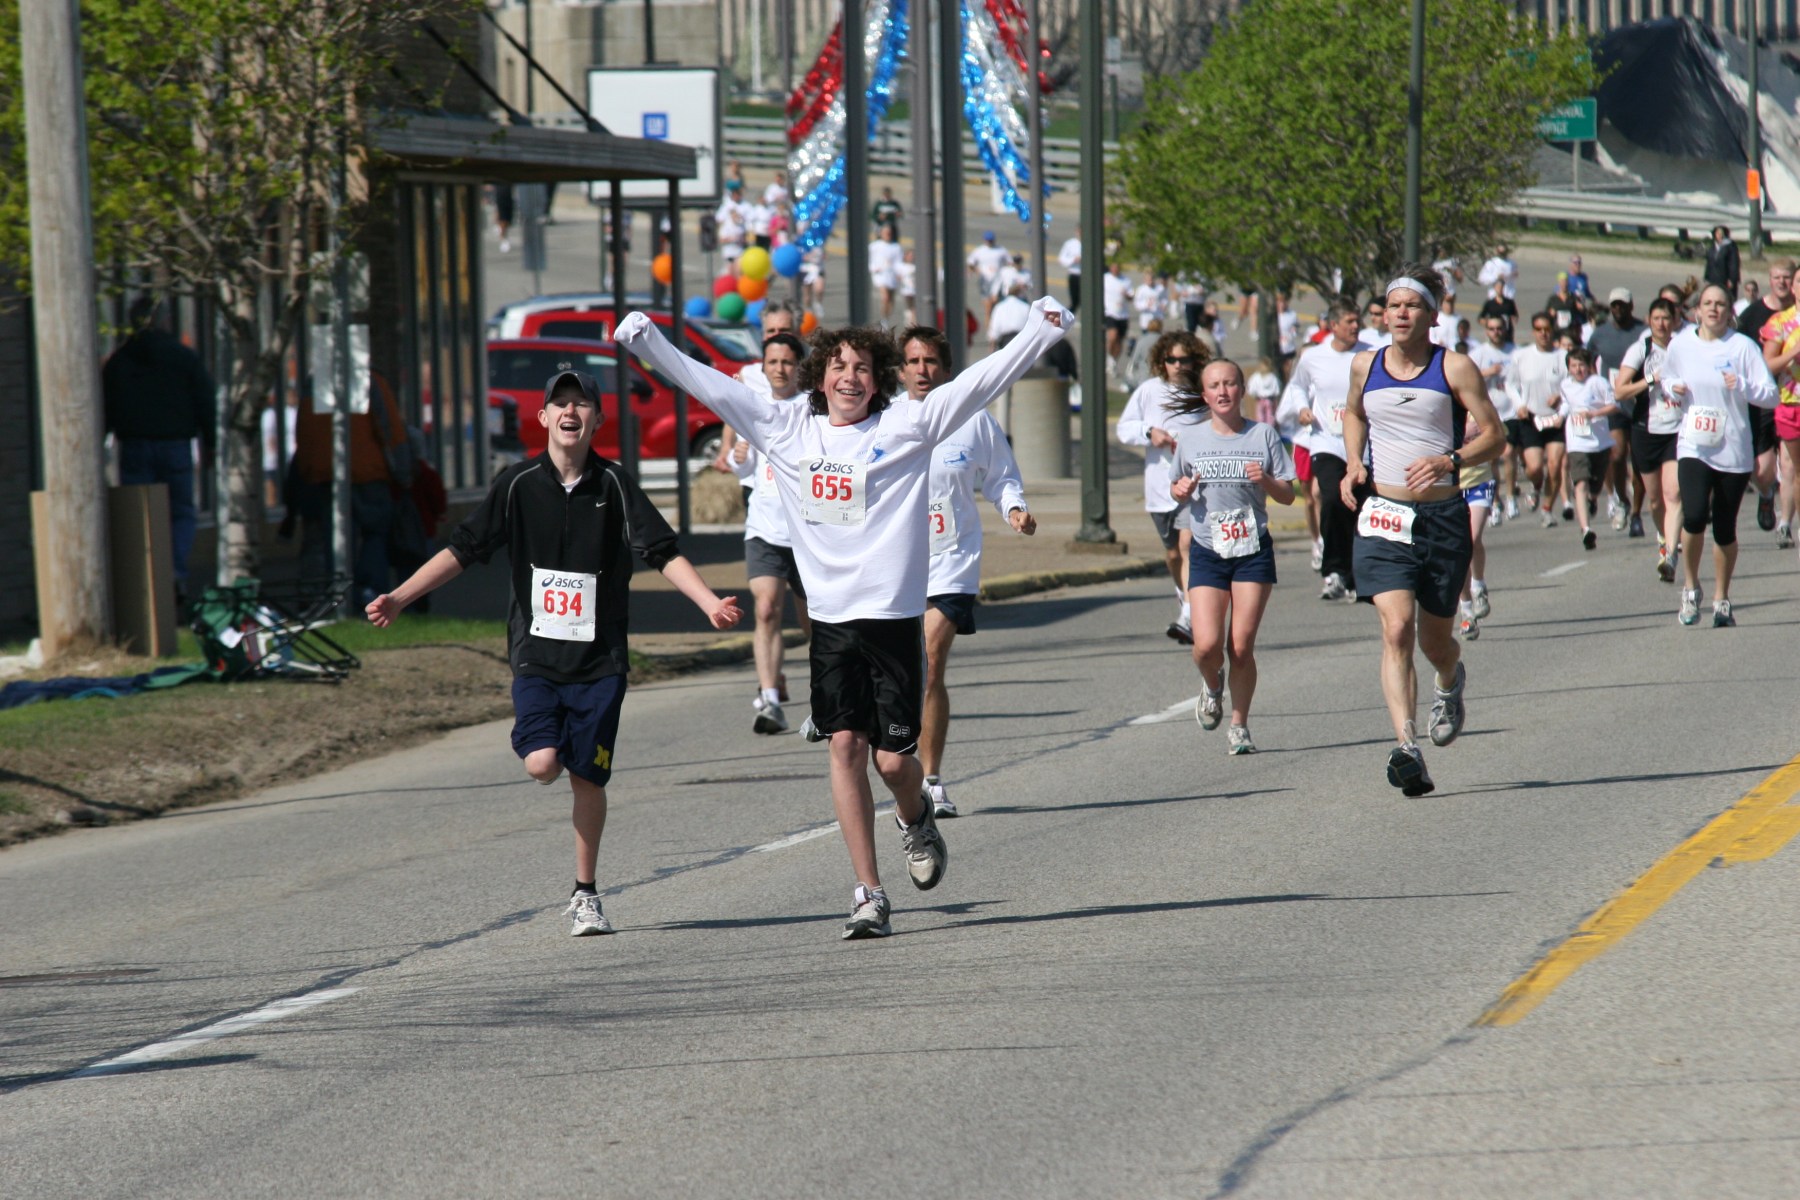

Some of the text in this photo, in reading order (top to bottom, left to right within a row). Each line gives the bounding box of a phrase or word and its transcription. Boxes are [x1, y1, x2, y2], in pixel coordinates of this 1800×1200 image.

[1694, 416, 1717, 433] 631
[1219, 460, 1263, 479] COUNT
[811, 473, 852, 501] 655
[1220, 521, 1249, 541] 561
[1369, 510, 1403, 533] 669
[543, 589, 582, 617] 634
